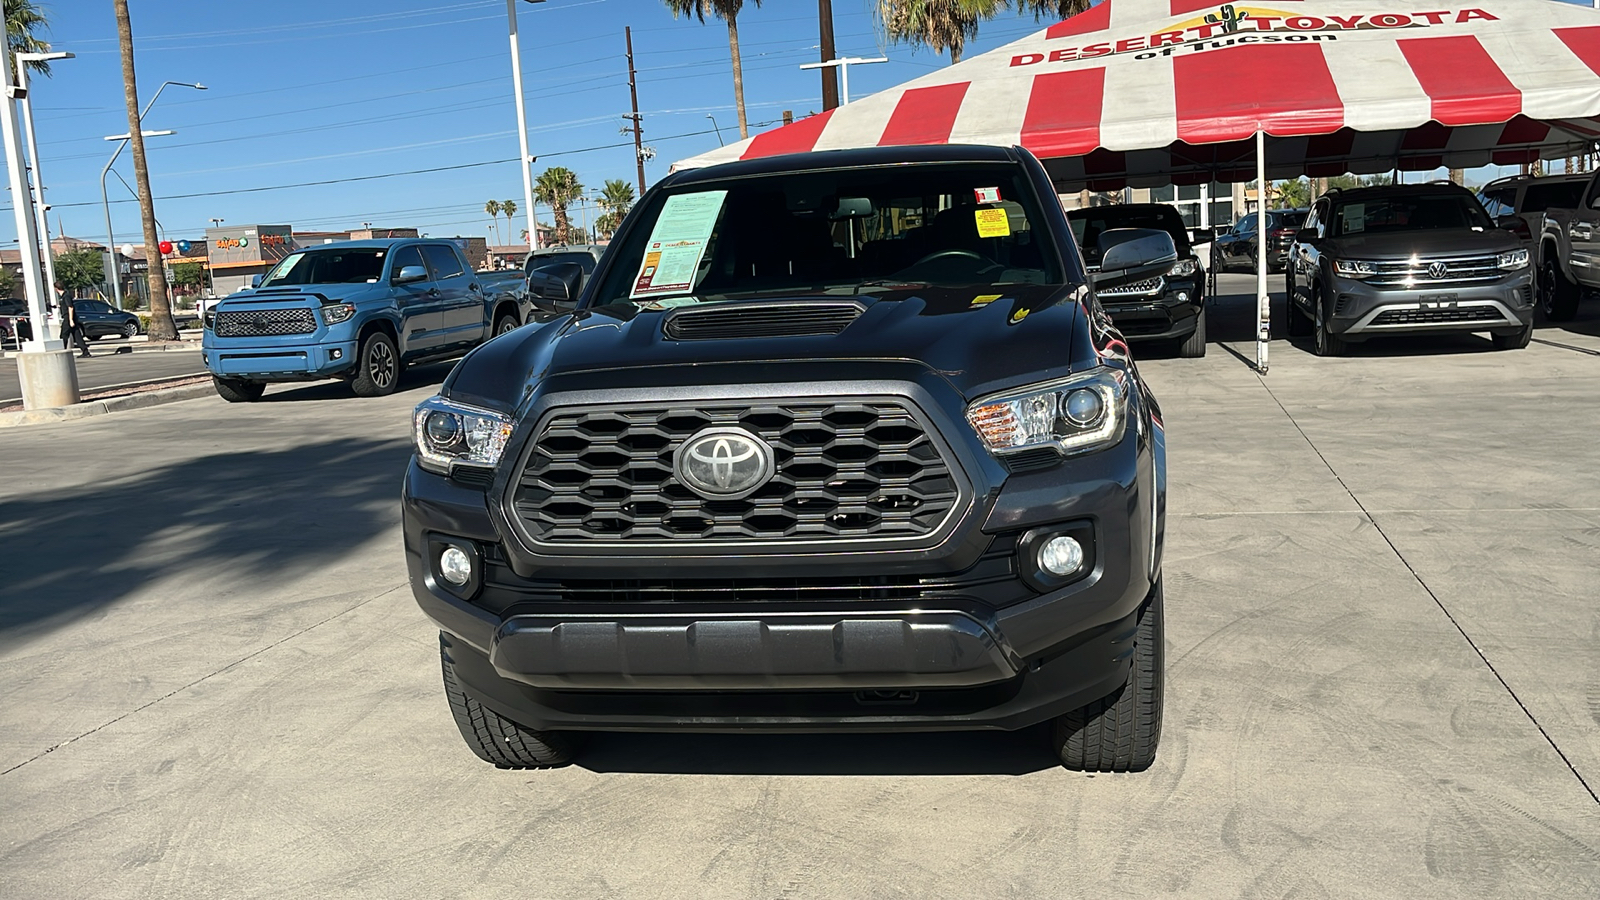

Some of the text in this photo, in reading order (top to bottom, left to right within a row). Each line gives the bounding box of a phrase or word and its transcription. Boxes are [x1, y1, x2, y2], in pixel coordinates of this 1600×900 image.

[1009, 8, 1501, 67] DESERT TOYOTA
[1134, 33, 1338, 60] of Tucson
